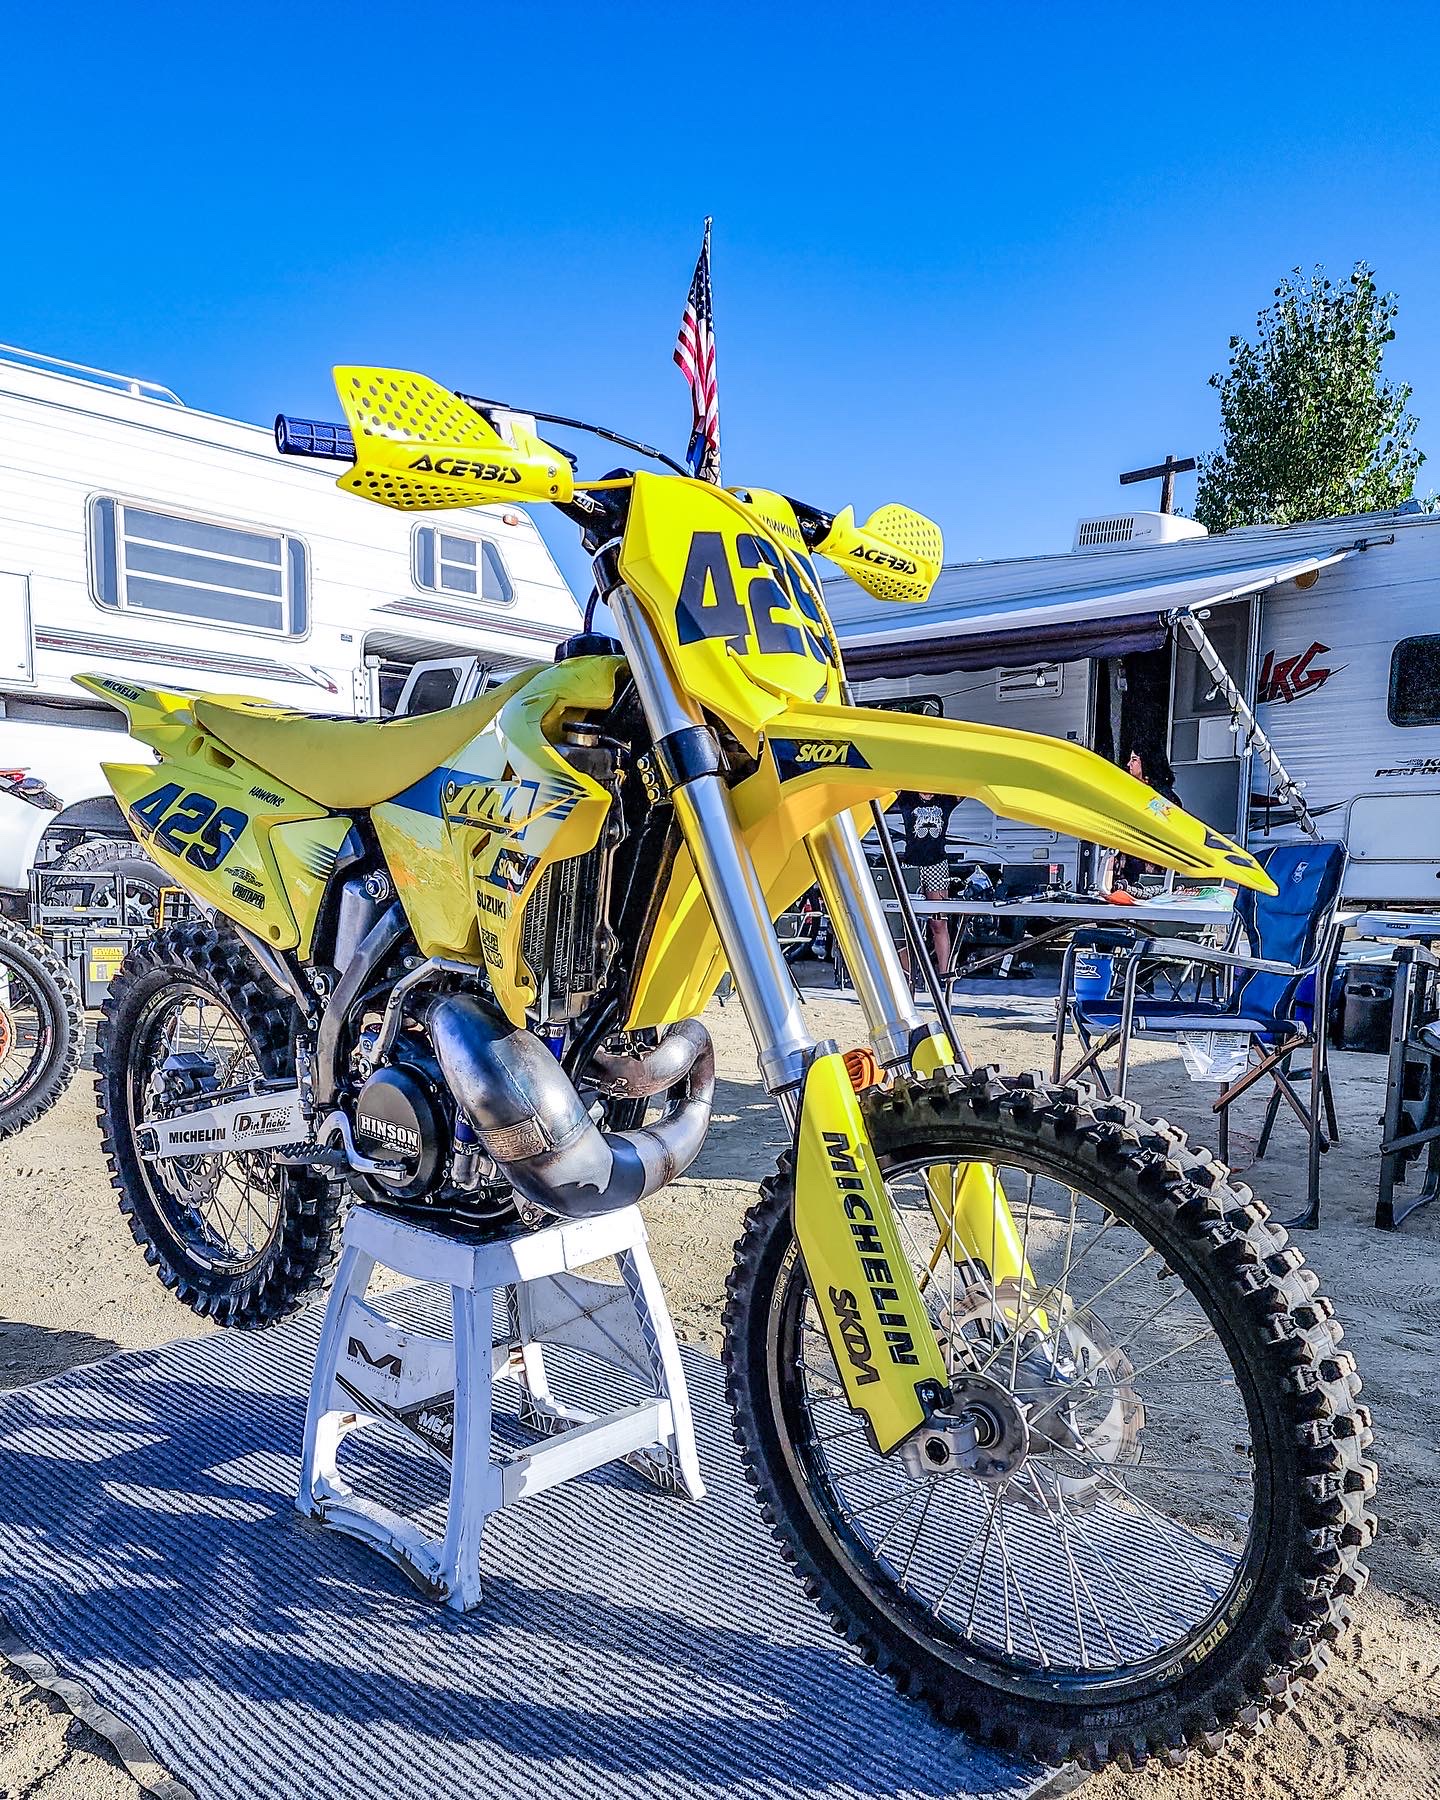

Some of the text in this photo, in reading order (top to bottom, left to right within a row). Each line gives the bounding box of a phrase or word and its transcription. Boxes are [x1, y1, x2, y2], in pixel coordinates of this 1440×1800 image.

[408, 454, 522, 484] ACERBIS
[849, 544, 917, 574] ACERBIS
[102, 679, 141, 701] MICHELIN
[795, 743, 849, 763] SKDA
[248, 786, 286, 807] HAWKINS
[129, 782, 249, 872] 429
[476, 889, 507, 920] SUZUKI
[168, 1128, 226, 1144] MICHELIN
[360, 1115, 418, 1147] HINSON
[821, 1131, 919, 1366] MICHELIN
[828, 1285, 881, 1386] SKDA
[1188, 1619, 1229, 1663] EXCEL
